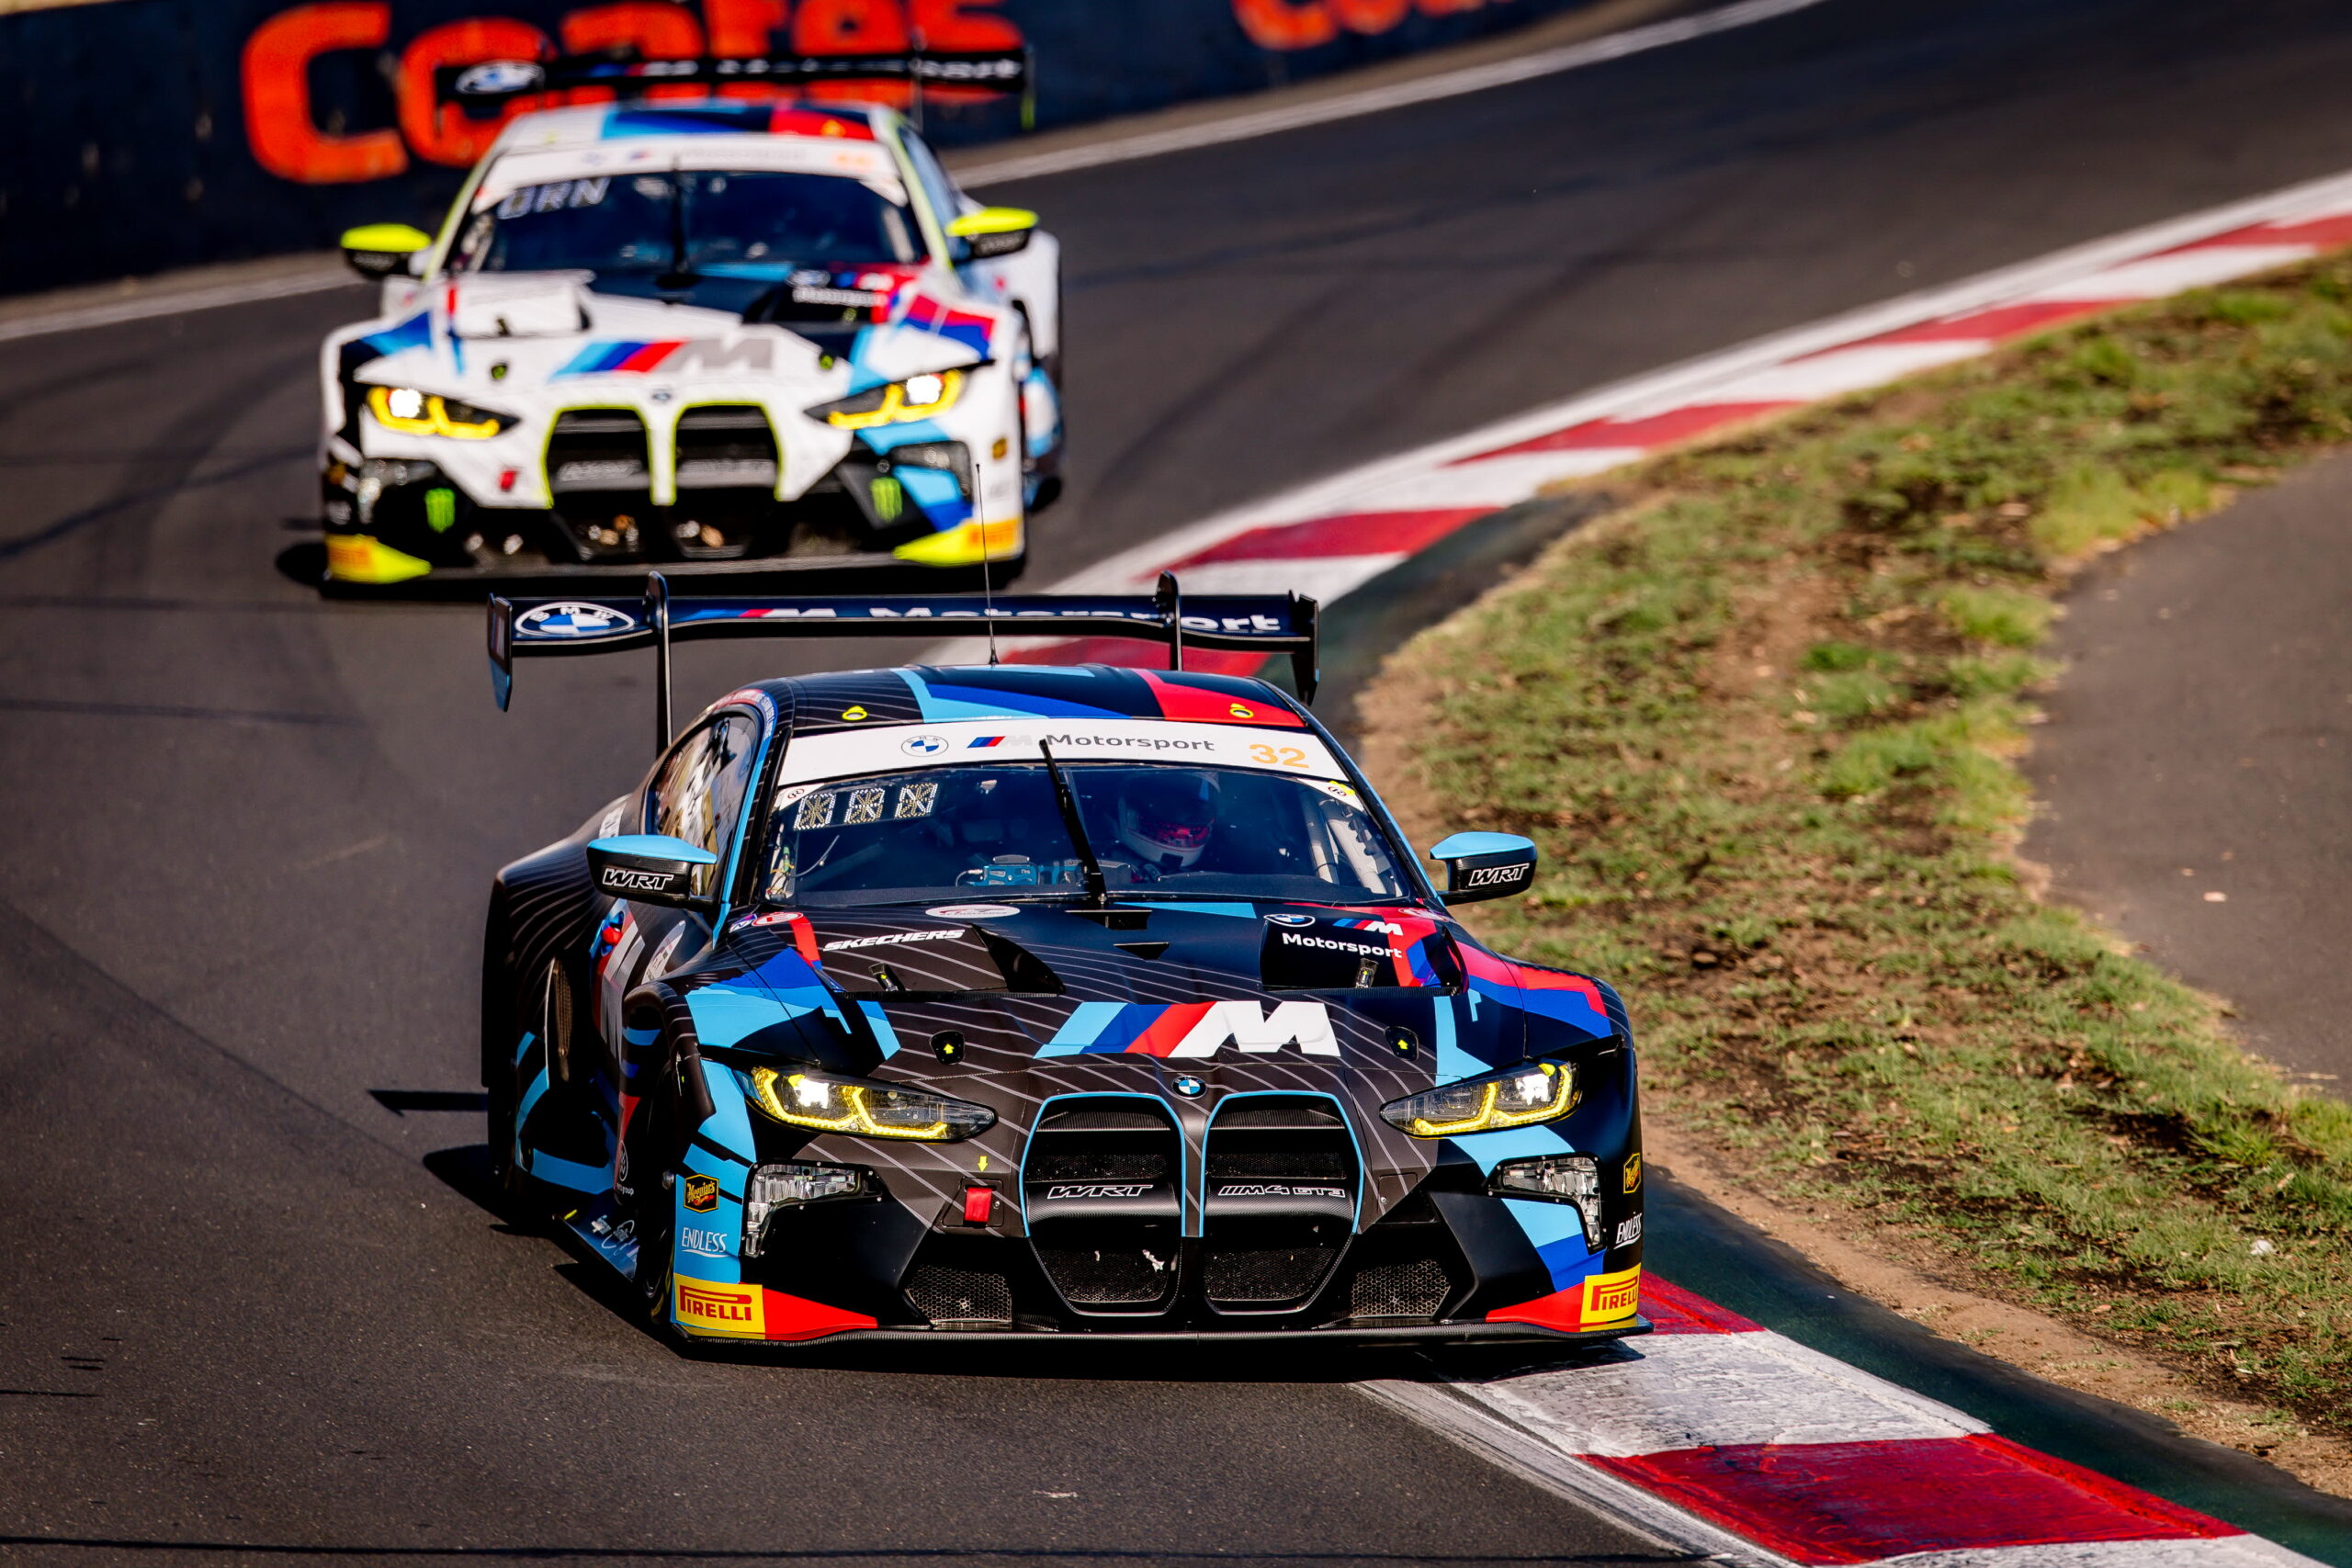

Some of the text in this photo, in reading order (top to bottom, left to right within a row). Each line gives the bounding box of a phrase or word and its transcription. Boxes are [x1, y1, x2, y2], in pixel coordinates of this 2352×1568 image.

[1046, 734, 1216, 751] Motorsport
[1250, 743, 1309, 769] 32
[603, 868, 673, 891] WRT
[1468, 863, 1530, 886] WRT
[824, 930, 966, 951] SKECHERS
[1282, 932, 1403, 958] Motorsport
[1047, 1185, 1153, 1199] WRT
[682, 1226, 728, 1253] ENDLESS
[1616, 1213, 1643, 1245] ENDLESS
[679, 1285, 752, 1321] PIRELLI
[1590, 1275, 1639, 1312] PIRELLI
